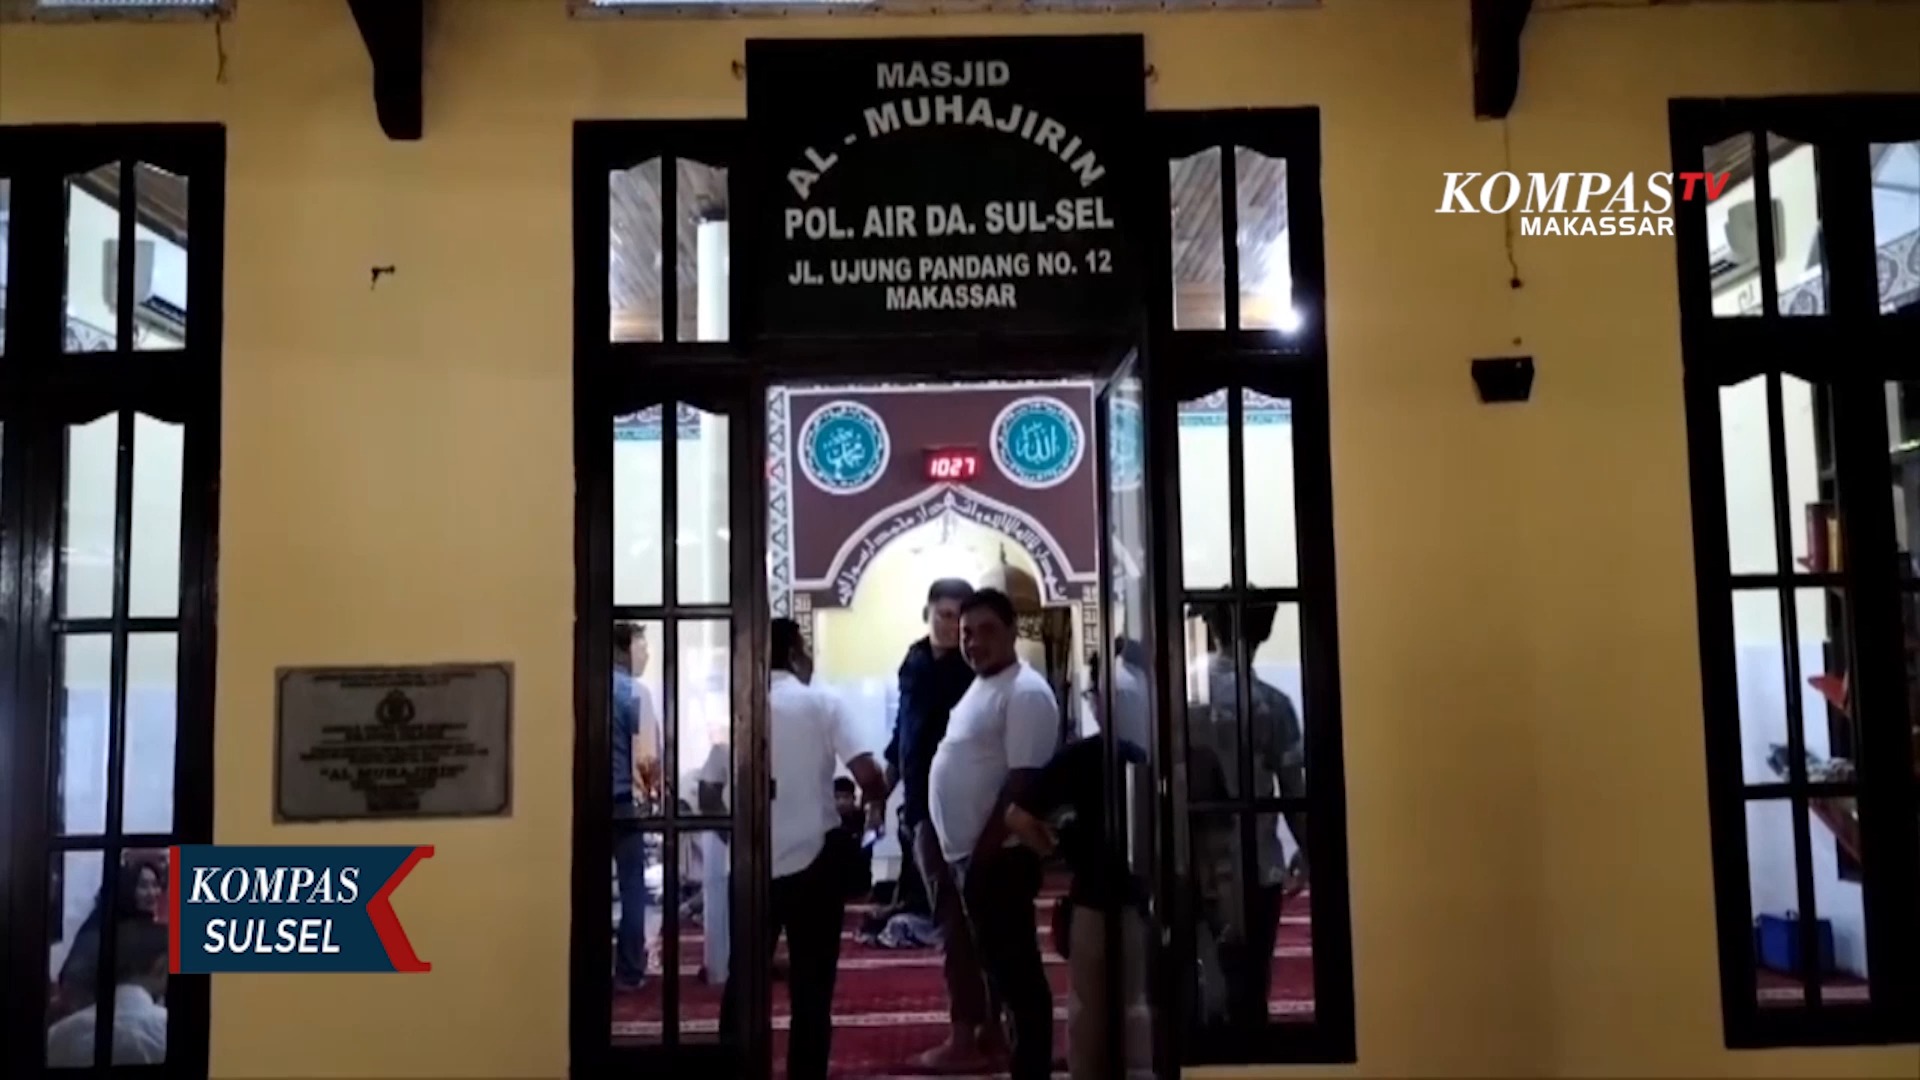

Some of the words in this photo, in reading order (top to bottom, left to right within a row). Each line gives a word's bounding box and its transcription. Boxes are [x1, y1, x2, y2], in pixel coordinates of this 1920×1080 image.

[877, 60, 1010, 89] MASJID
[786, 146, 839, 200] AL
[863, 94, 1106, 188] MUHAJIRIN
[784, 207, 855, 240] POL.
[862, 205, 918, 238] AIR
[925, 203, 977, 236] DA.
[984, 196, 1115, 234] SUL-SEL
[788, 259, 824, 286] JL.
[830, 256, 913, 284] UJUNG
[918, 253, 1031, 282] PANDANG
[1036, 251, 1078, 277] NO.
[1084, 249, 1113, 274] 12
[885, 283, 1018, 311] MAKASSAR
